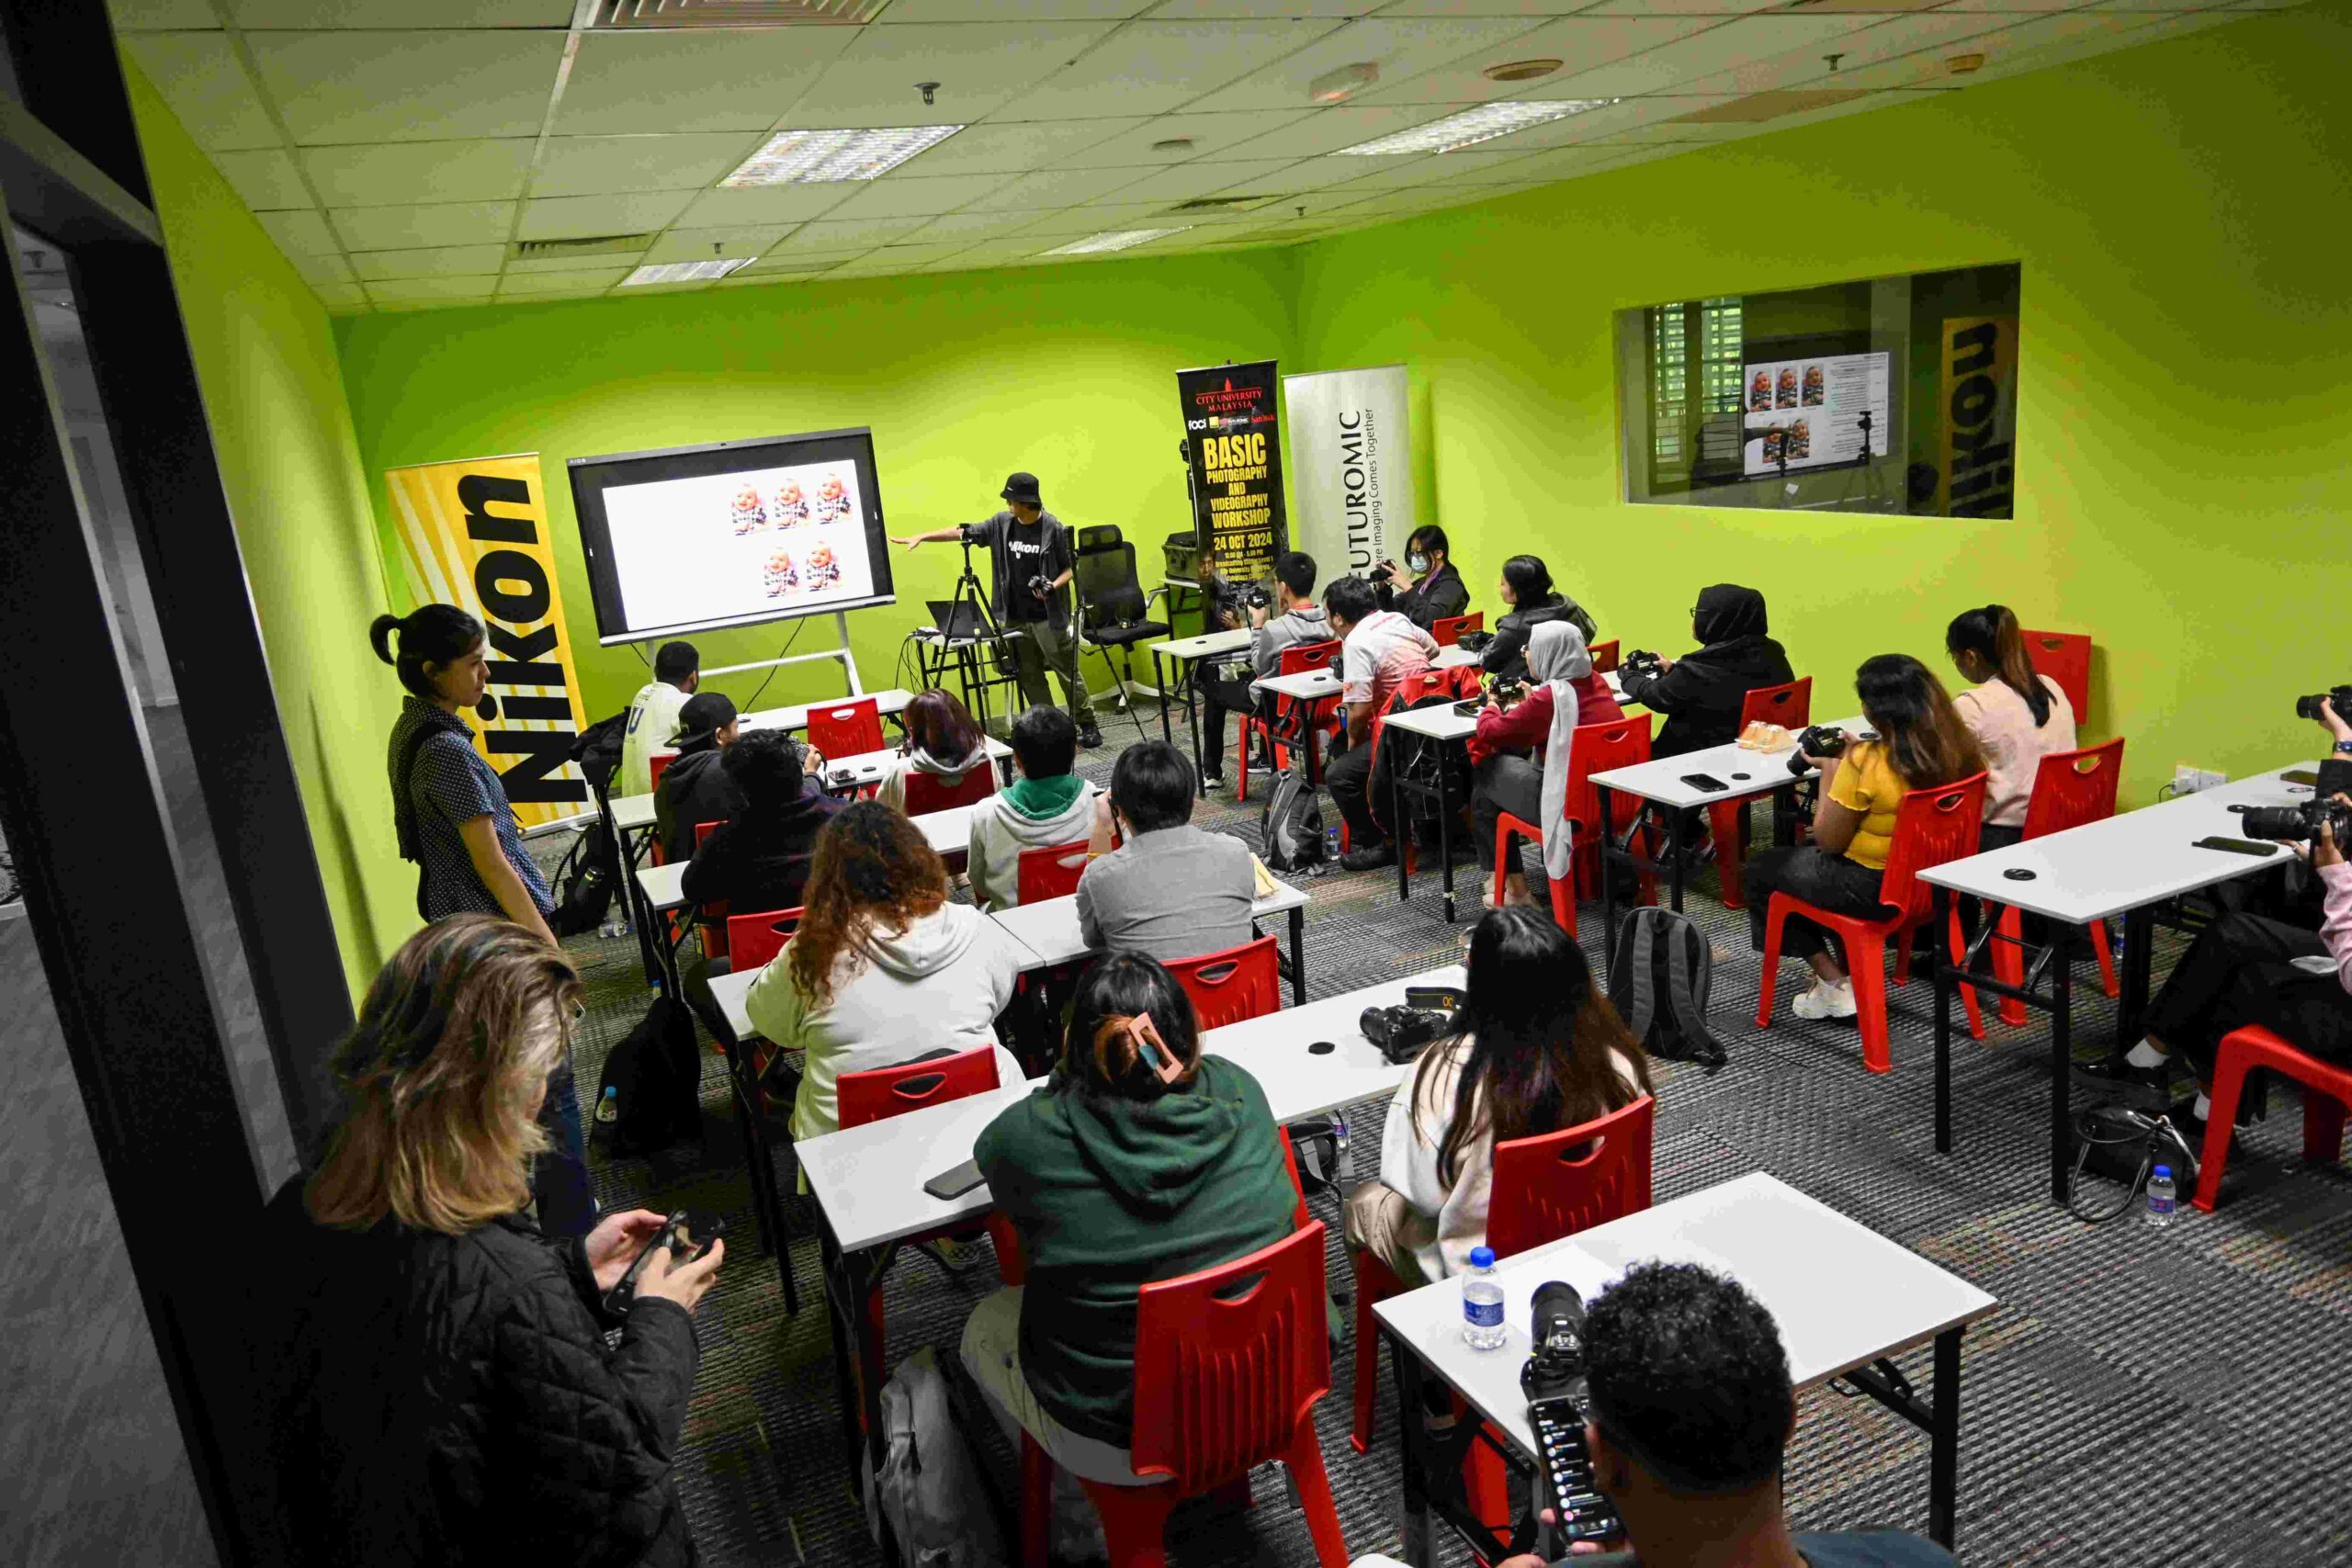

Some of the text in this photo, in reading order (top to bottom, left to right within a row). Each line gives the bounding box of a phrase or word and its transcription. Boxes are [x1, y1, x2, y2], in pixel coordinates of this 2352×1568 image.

[1195, 390, 1262, 405] CITY UNIVERSITY
[1208, 400, 1254, 412] MALAYSIA
[1363, 408, 1378, 458] Together
[1203, 432, 1267, 470] BASIC
[1205, 466, 1267, 484] PHOTOGRAPHY
[1369, 460, 1379, 498] Comes
[1227, 481, 1246, 496] AND
[1210, 493, 1268, 512] VIDEOGRAPHY
[1212, 508, 1271, 529] WORKSHOP
[1371, 501, 1384, 546] Imaging
[1214, 532, 1272, 551] 24 OCT 2024
[457, 474, 589, 803] Nikon
